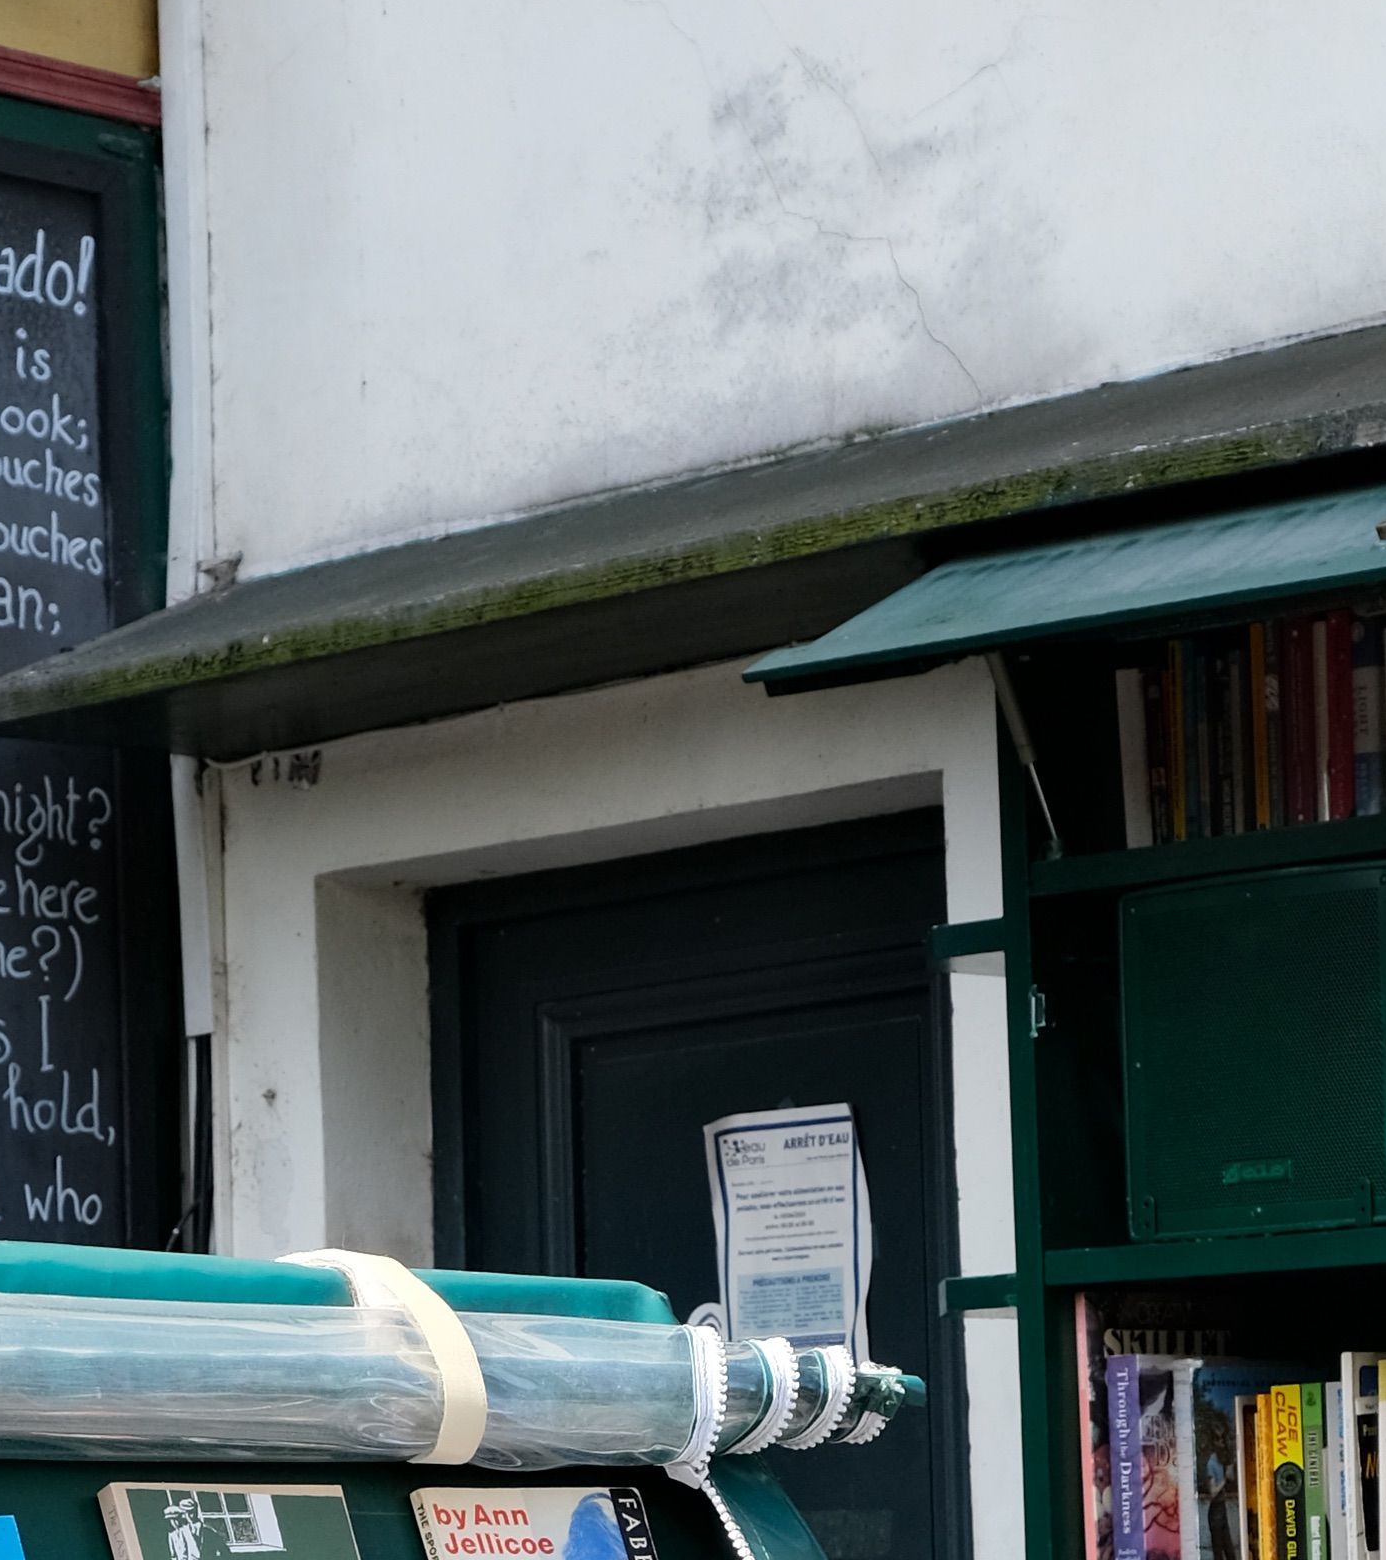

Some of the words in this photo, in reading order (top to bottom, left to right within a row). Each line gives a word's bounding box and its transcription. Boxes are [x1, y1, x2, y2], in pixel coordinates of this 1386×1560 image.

[15, 327, 51, 382] is
[16, 864, 99, 923] here
[38, 995, 55, 1071] I
[4, 1062, 115, 1146] hold,
[24, 1155, 103, 1226] who
[1115, 1368, 1131, 1437] Through
[1119, 1441, 1130, 1458] the
[432, 1503, 466, 1531] by
[473, 1503, 529, 1527] Ann
[1119, 1461, 1134, 1534] Darkness
[1284, 1499, 1298, 1538] DAVID
[444, 1533, 554, 1556] Jellicoe
